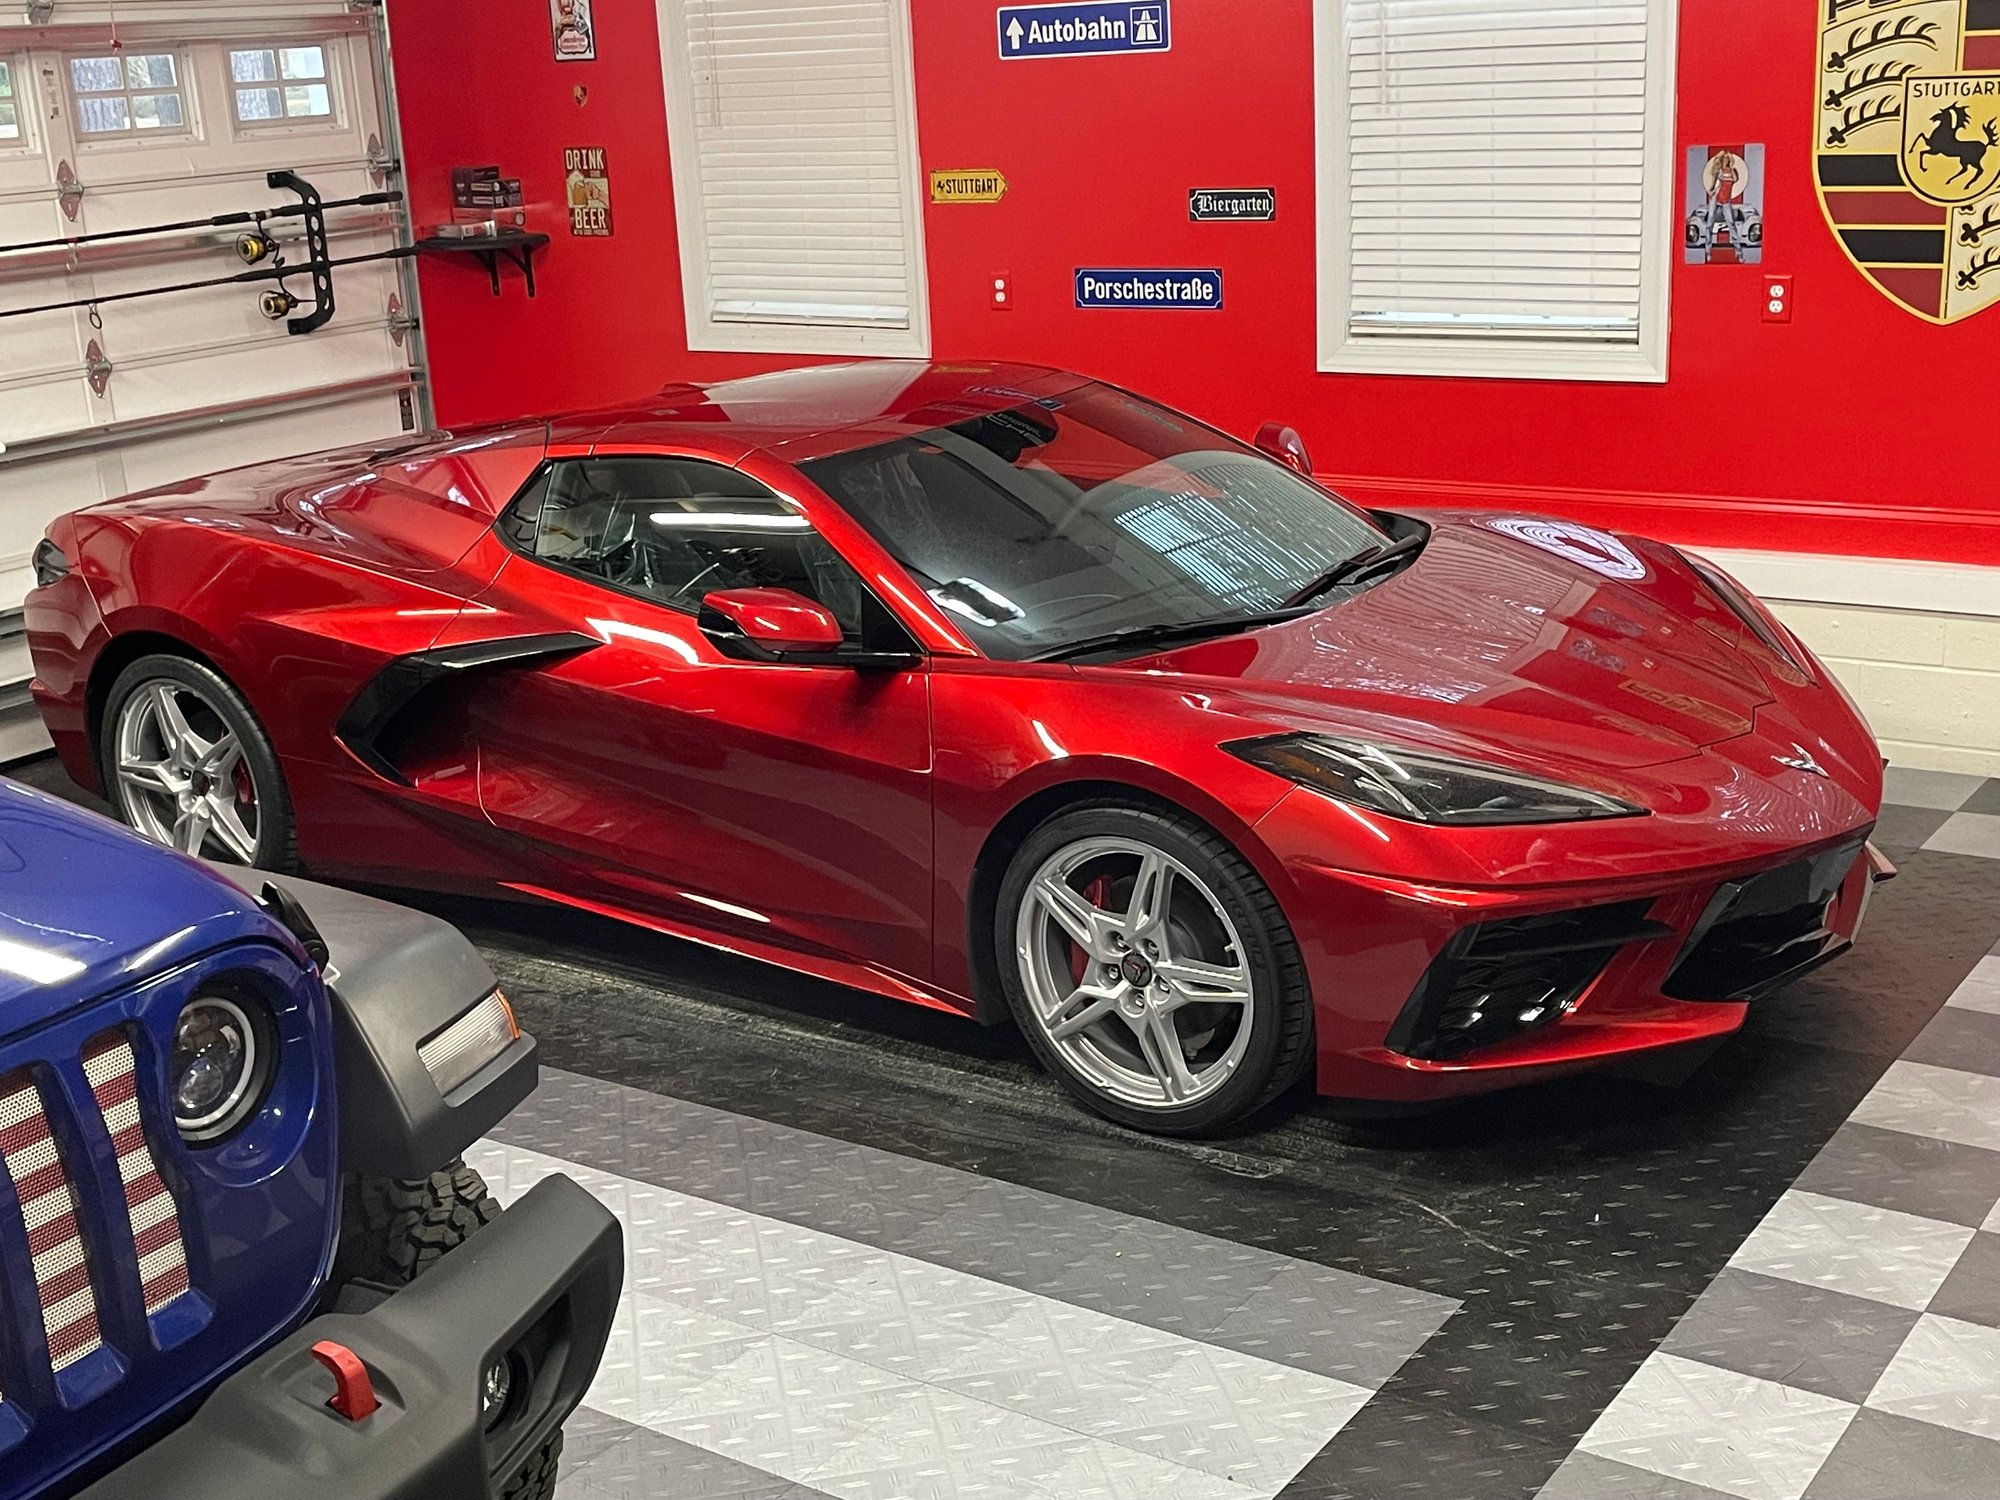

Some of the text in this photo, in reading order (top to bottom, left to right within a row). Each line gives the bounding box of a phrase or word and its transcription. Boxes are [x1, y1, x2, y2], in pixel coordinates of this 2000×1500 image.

[1028, 16, 1126, 43] Autobahn
[565, 149, 605, 170] DRINK
[946, 178, 998, 194] STUTTGART
[1197, 194, 1270, 215] Biergarten
[575, 208, 607, 229] BEER
[1084, 277, 1213, 300] Porschestraße
